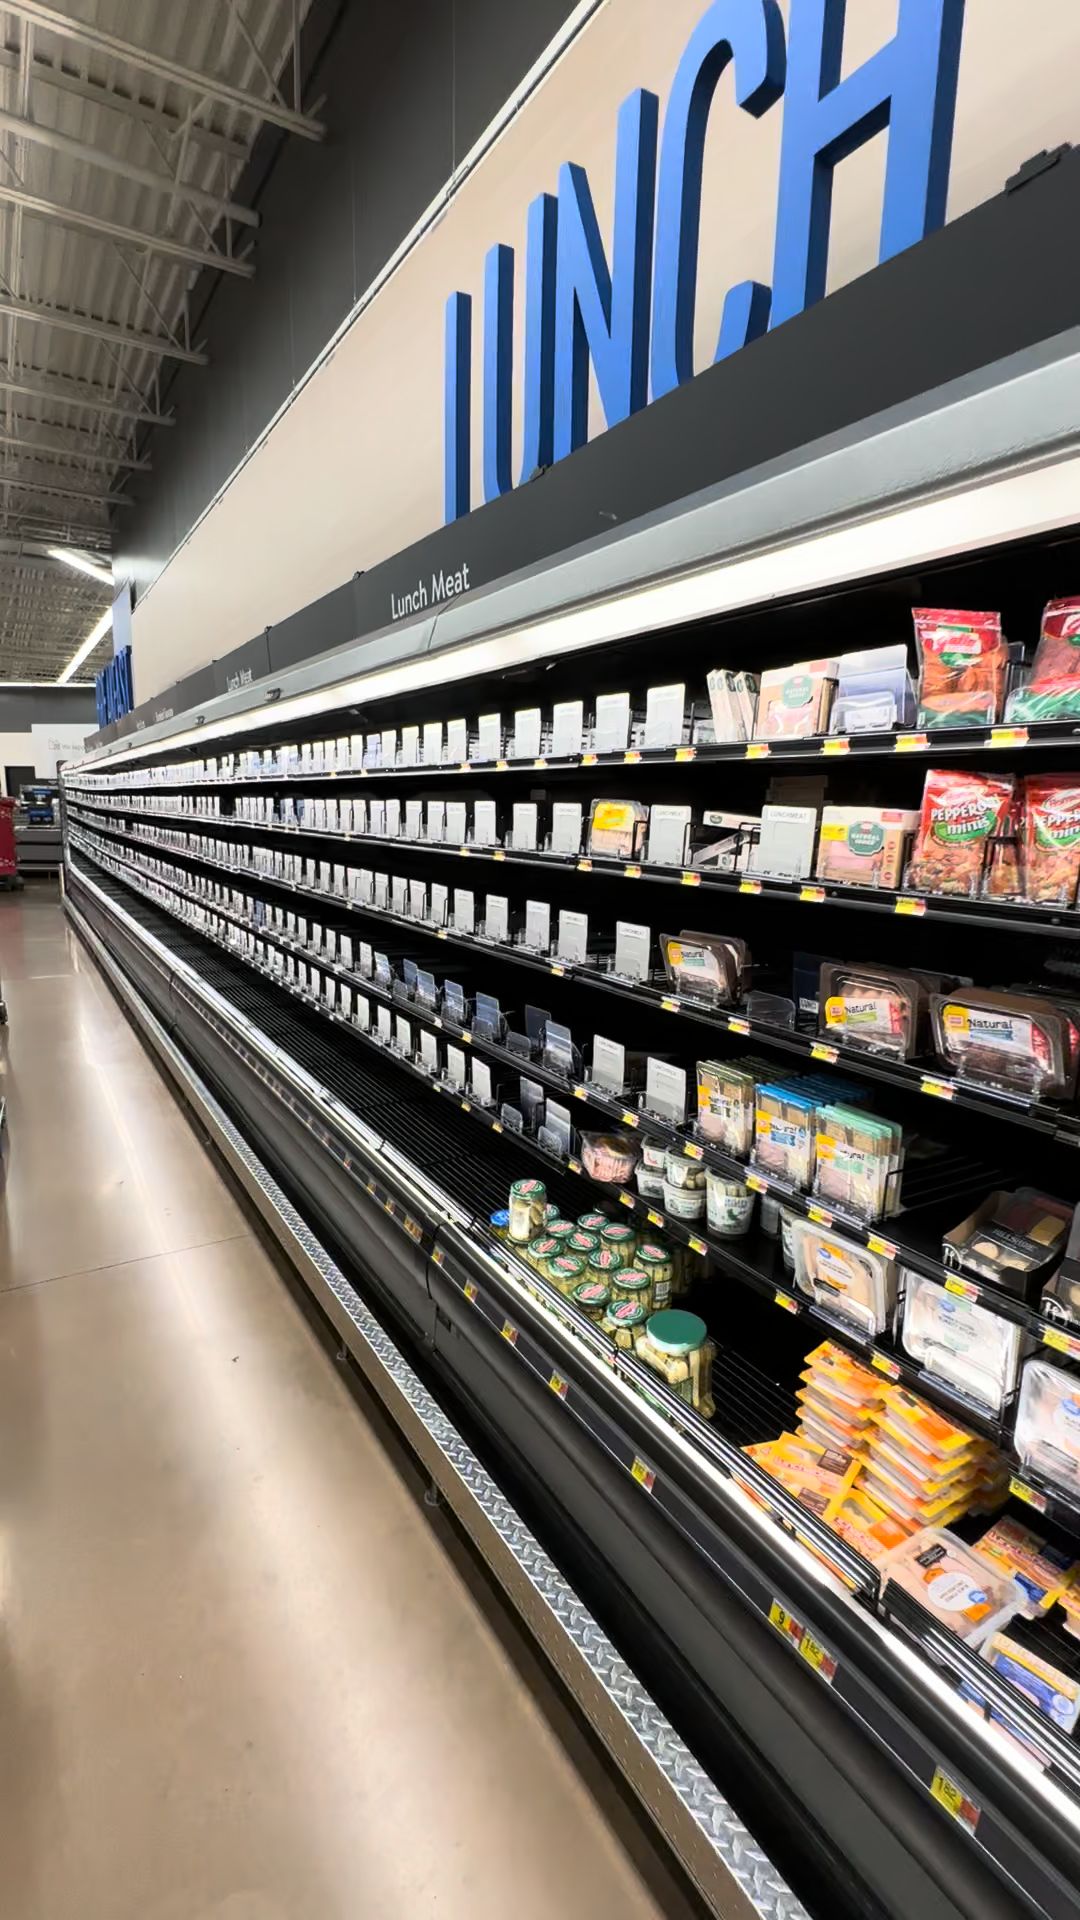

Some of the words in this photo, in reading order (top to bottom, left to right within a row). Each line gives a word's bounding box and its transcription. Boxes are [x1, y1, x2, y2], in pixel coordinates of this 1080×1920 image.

[391, 579, 428, 620] Lunch
[431, 562, 470, 604] Meat
[947, 816, 990, 835] minis
[845, 1001, 877, 1014] Natural
[967, 1018, 1013, 1030] Natural
